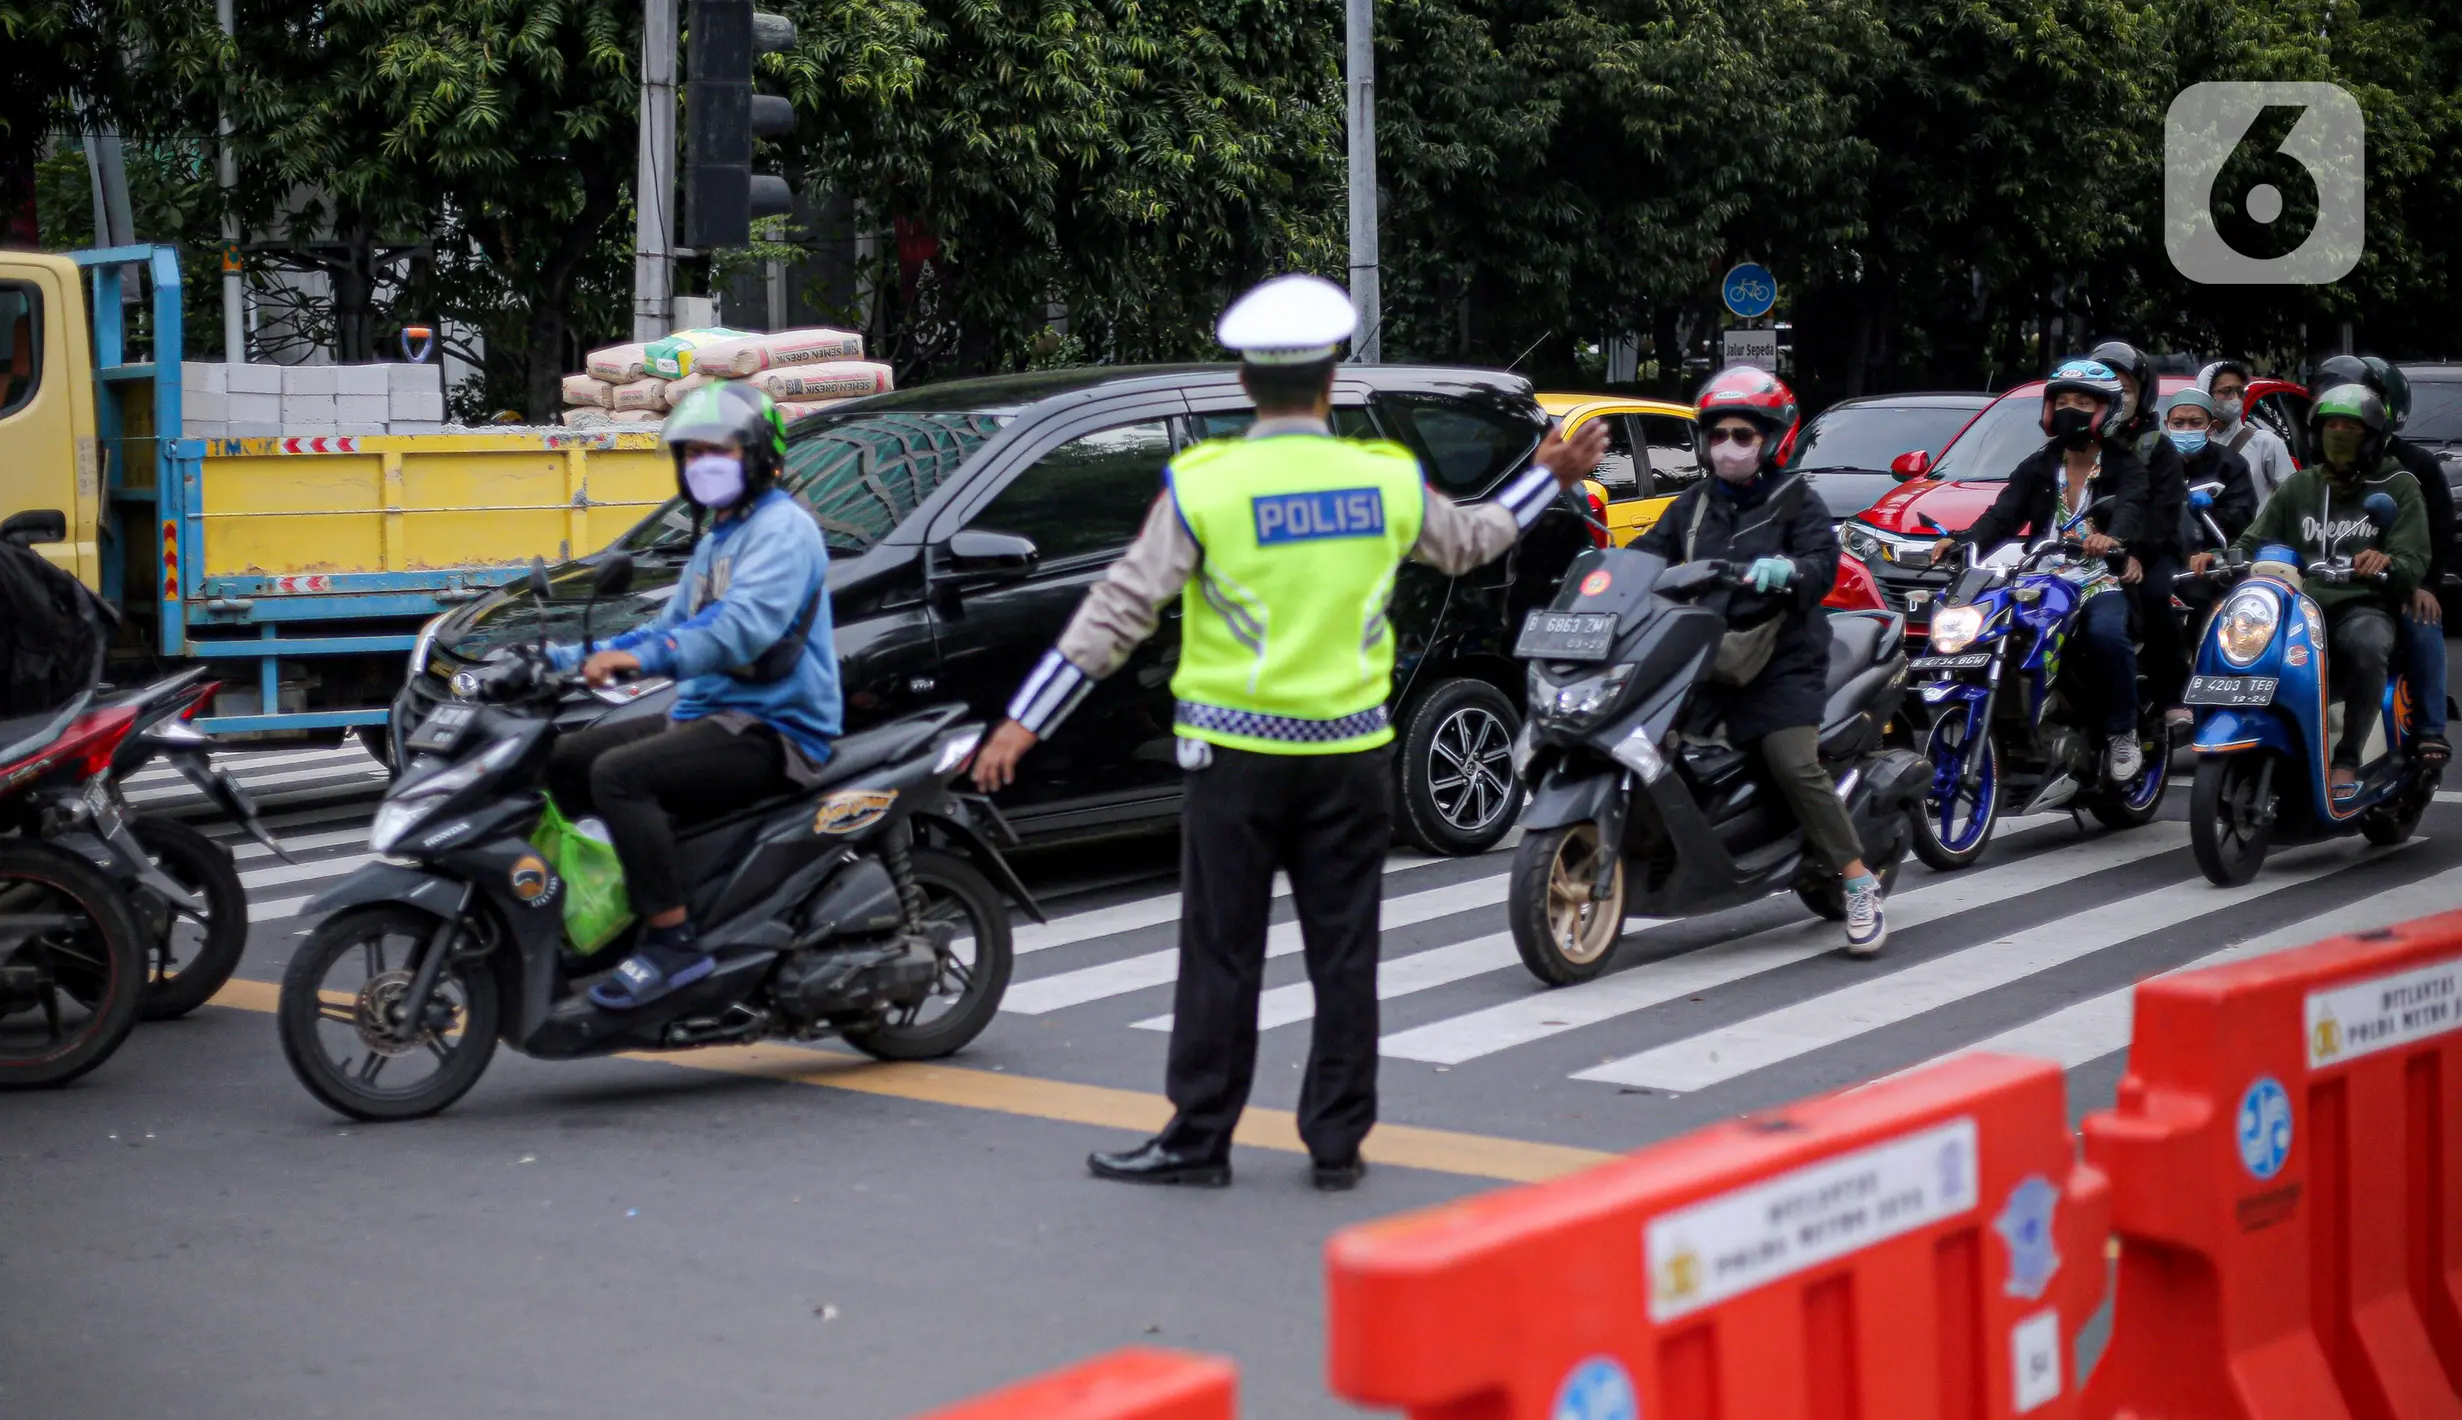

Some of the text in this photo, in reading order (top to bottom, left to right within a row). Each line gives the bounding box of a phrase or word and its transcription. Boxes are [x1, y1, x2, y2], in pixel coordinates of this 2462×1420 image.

[776, 348, 841, 365] SEMEN GRESIK
[1726, 343, 1775, 360] Jalur Sepeda
[806, 383, 838, 395] GRESIK
[839, 381, 870, 393] SEMEN
[1259, 494, 1381, 539] POLISI
[1528, 616, 1539, 632] B
[1546, 618, 1580, 633] 6863
[2193, 678, 2274, 691] B 4203 TEB
[2232, 695, 2267, 703] 12-24
[422, 821, 472, 848] HONDA
